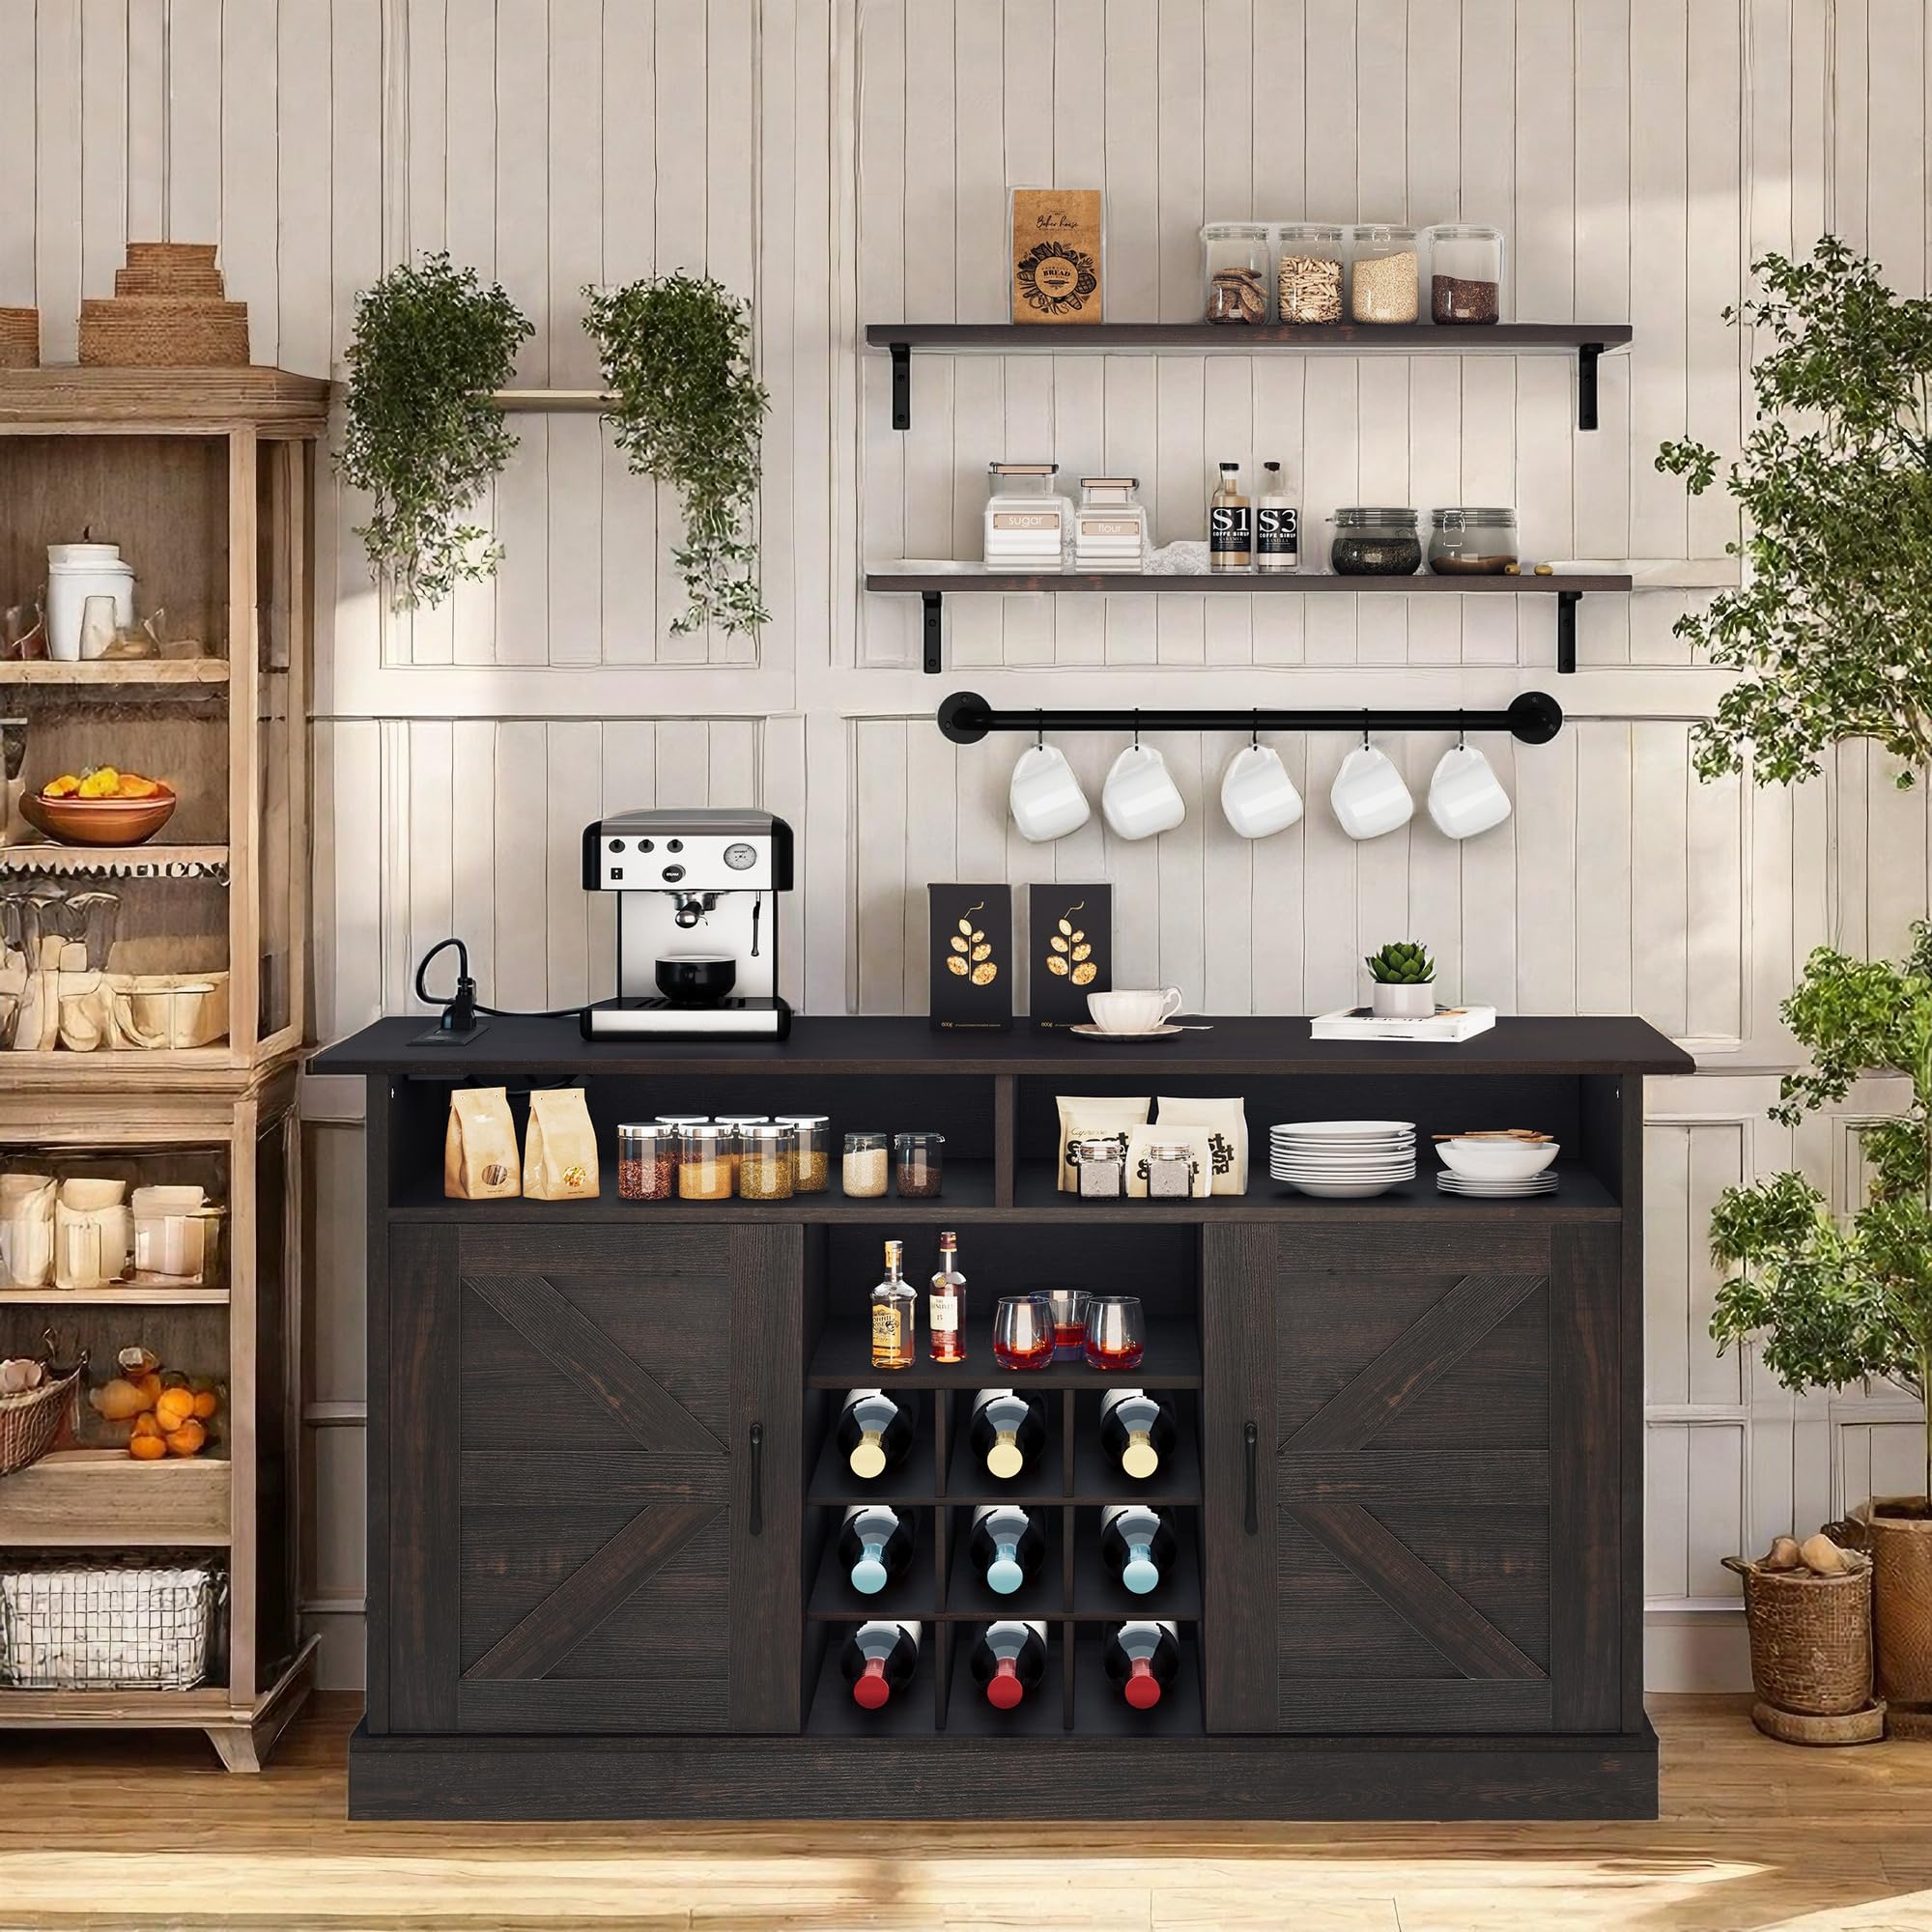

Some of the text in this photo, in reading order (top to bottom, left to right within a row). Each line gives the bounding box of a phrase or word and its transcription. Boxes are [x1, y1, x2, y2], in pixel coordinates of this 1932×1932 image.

[1009, 515, 1044, 527] sugar
[1212, 508, 1249, 531] S1
[1259, 509, 1296, 533] S3
[1097, 524, 1122, 533] flour
